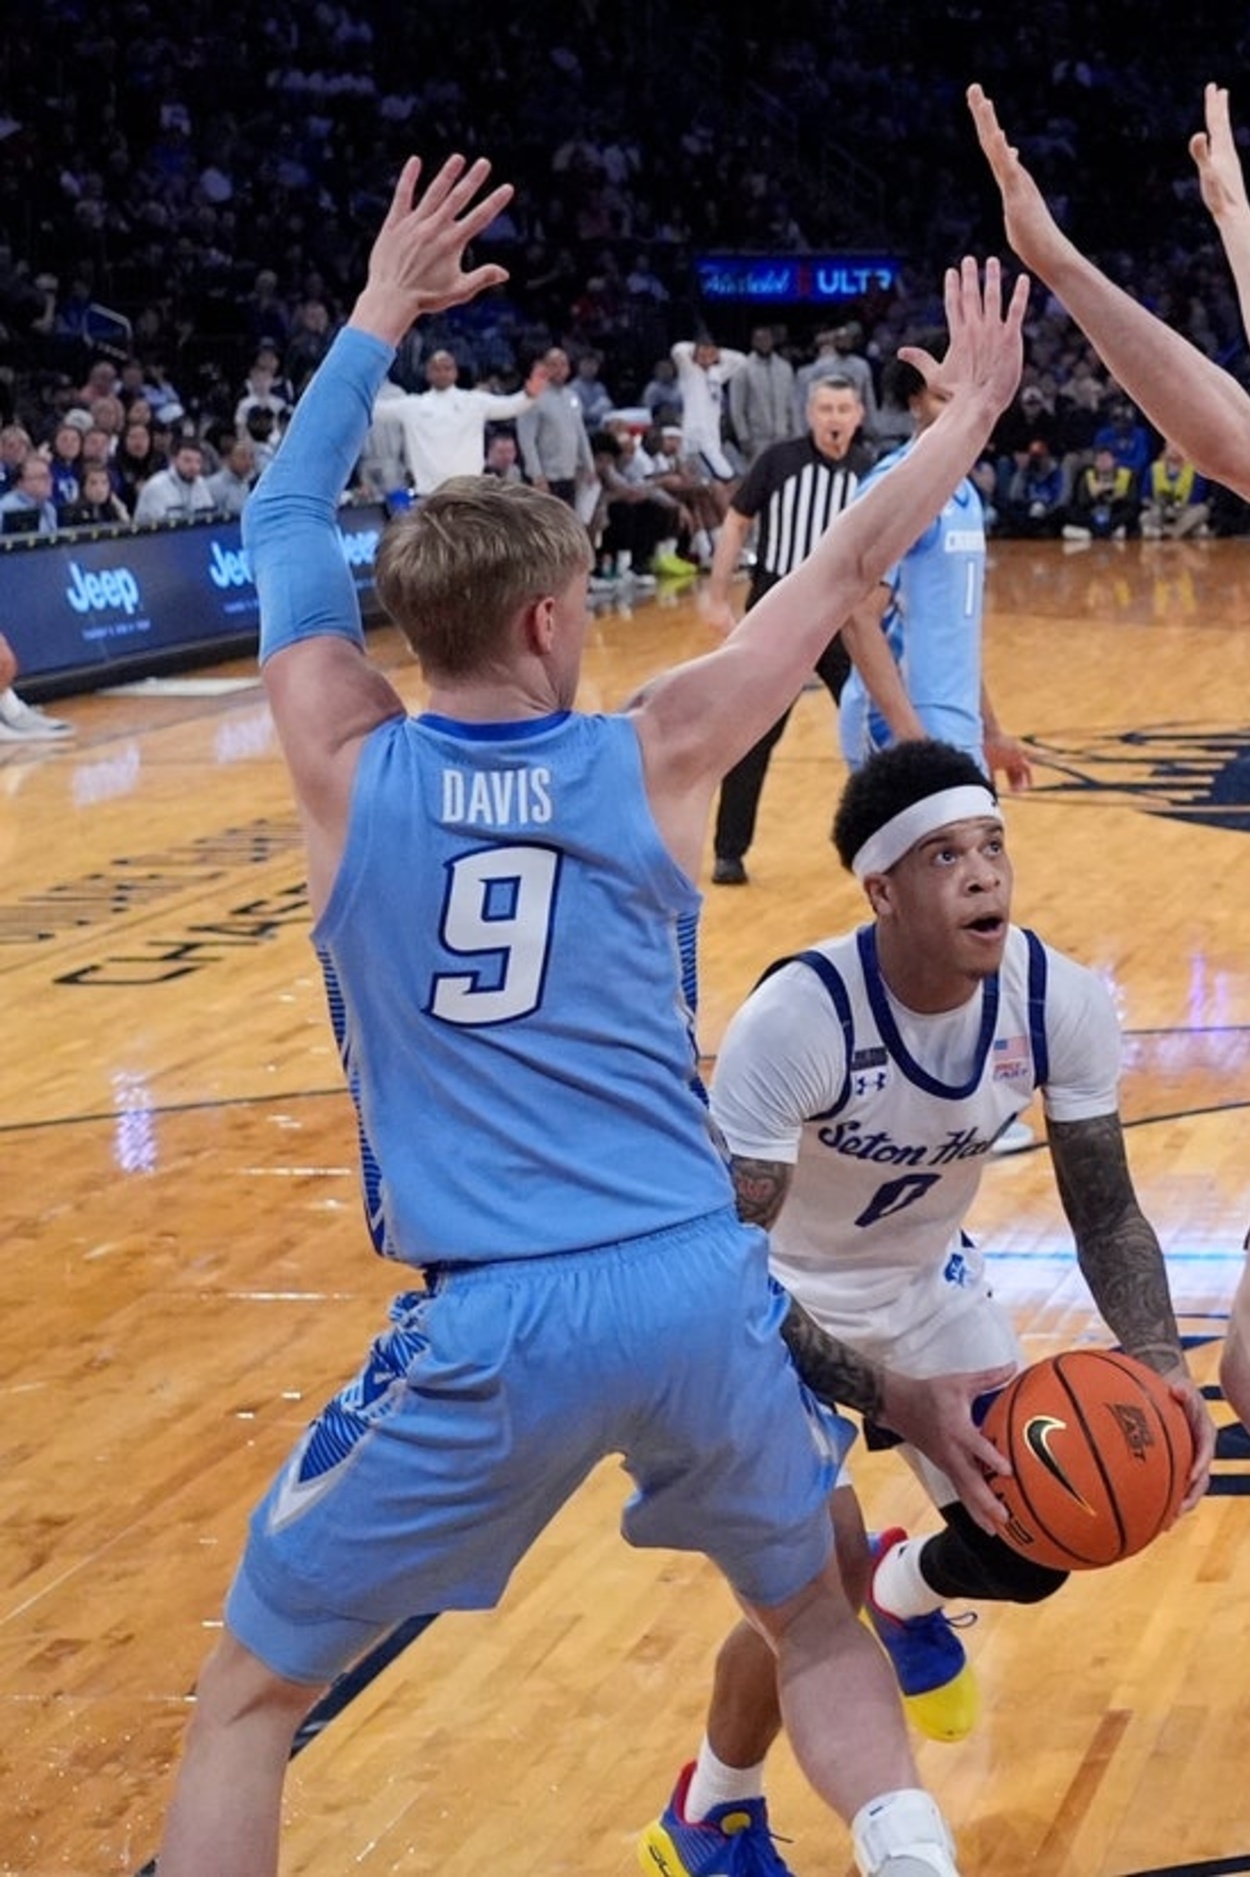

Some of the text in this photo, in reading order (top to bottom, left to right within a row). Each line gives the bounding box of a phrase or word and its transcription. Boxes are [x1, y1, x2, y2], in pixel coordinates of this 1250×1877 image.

[67, 562, 141, 614] Jeep
[441, 766, 552, 825] DAVIS
[421, 840, 563, 1029] 9
[818, 1120, 928, 1166] Seton
